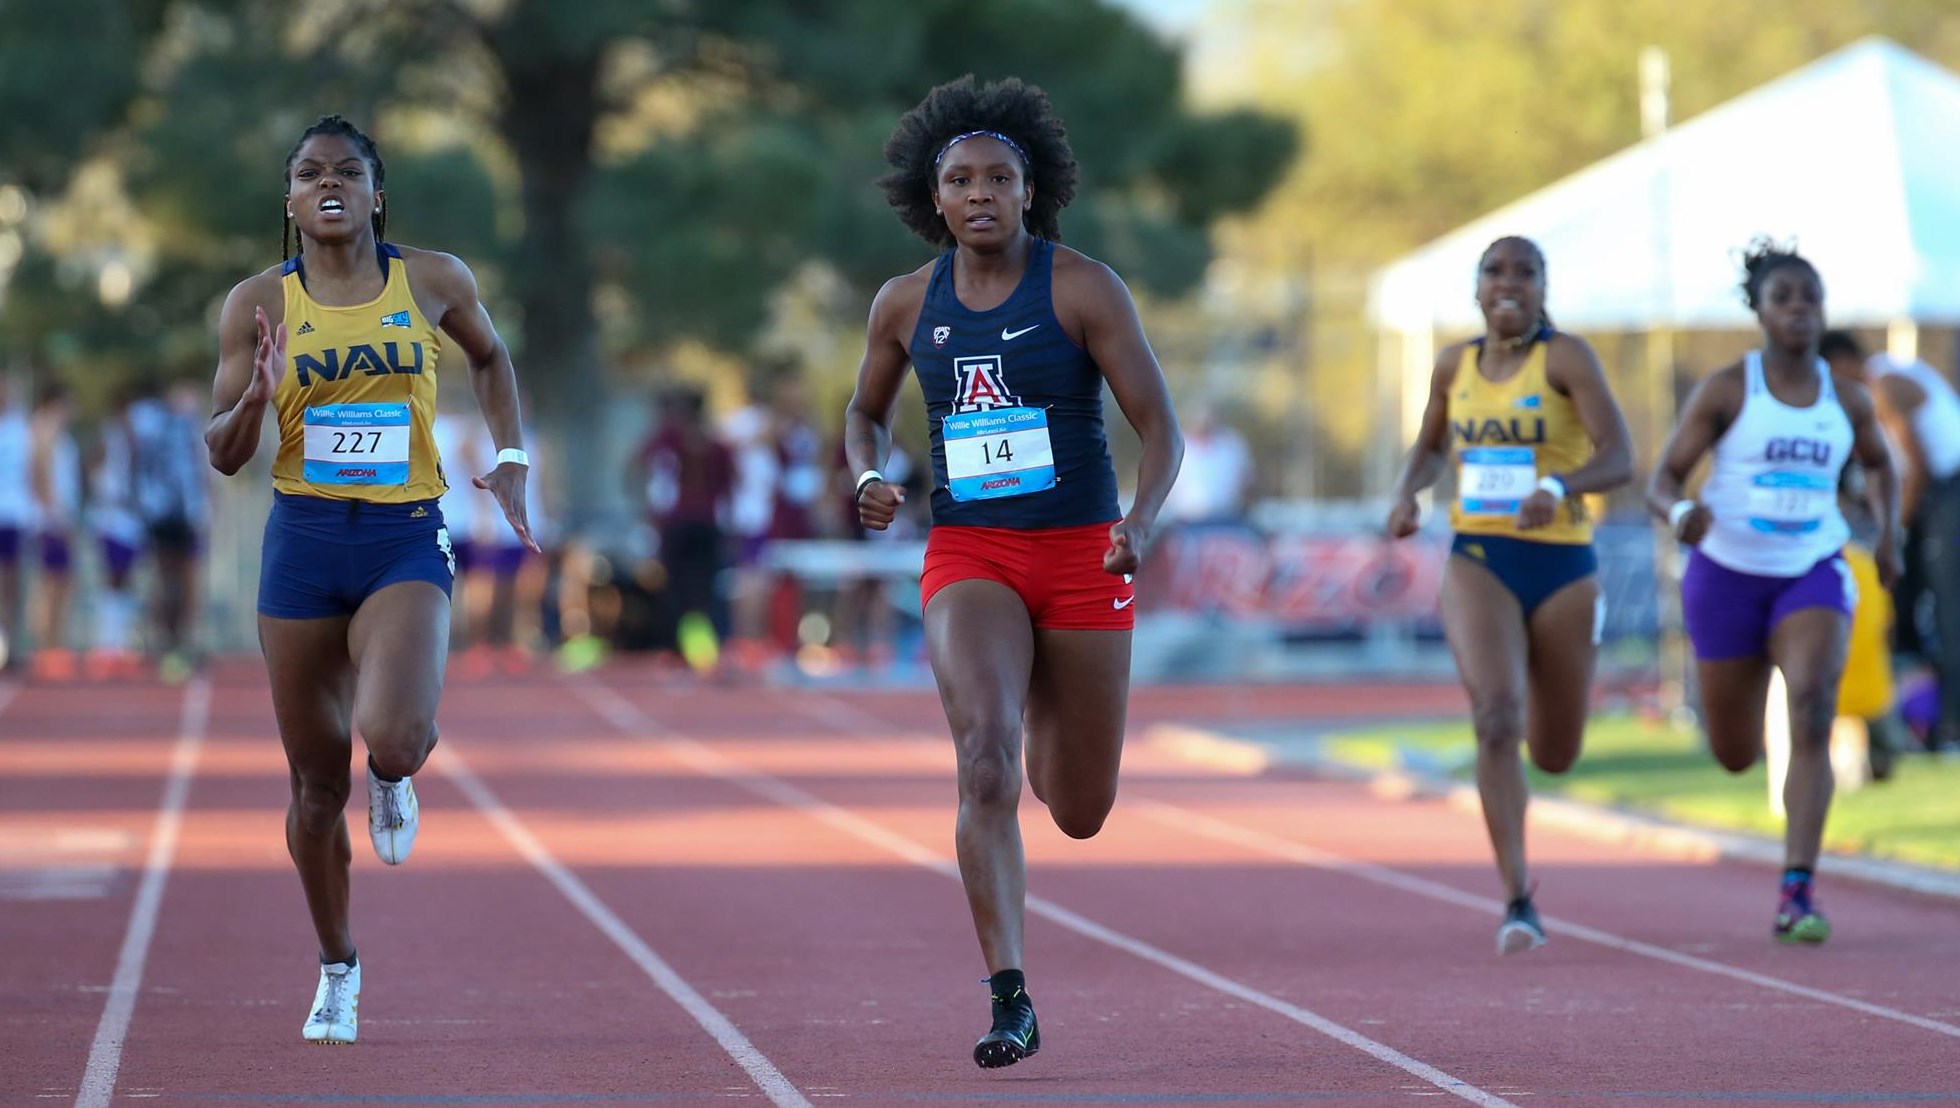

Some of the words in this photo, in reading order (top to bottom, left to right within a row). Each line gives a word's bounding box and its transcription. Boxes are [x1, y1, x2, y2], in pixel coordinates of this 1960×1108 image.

[292, 341, 424, 388] NAU
[953, 354, 1023, 416] A
[311, 408, 336, 418] Willie
[337, 409, 373, 418] Williams
[374, 409, 403, 418] Classic
[948, 420, 970, 431] Willie
[971, 416, 1007, 428] Williams
[1007, 411, 1038, 423] Classic
[331, 431, 382, 454] 227
[1451, 417, 1547, 444] NAU
[981, 438, 1014, 466] 14
[1765, 436, 1832, 468] GCU
[336, 468, 377, 477] ARIZONA
[981, 476, 1021, 491] ARIZONA
